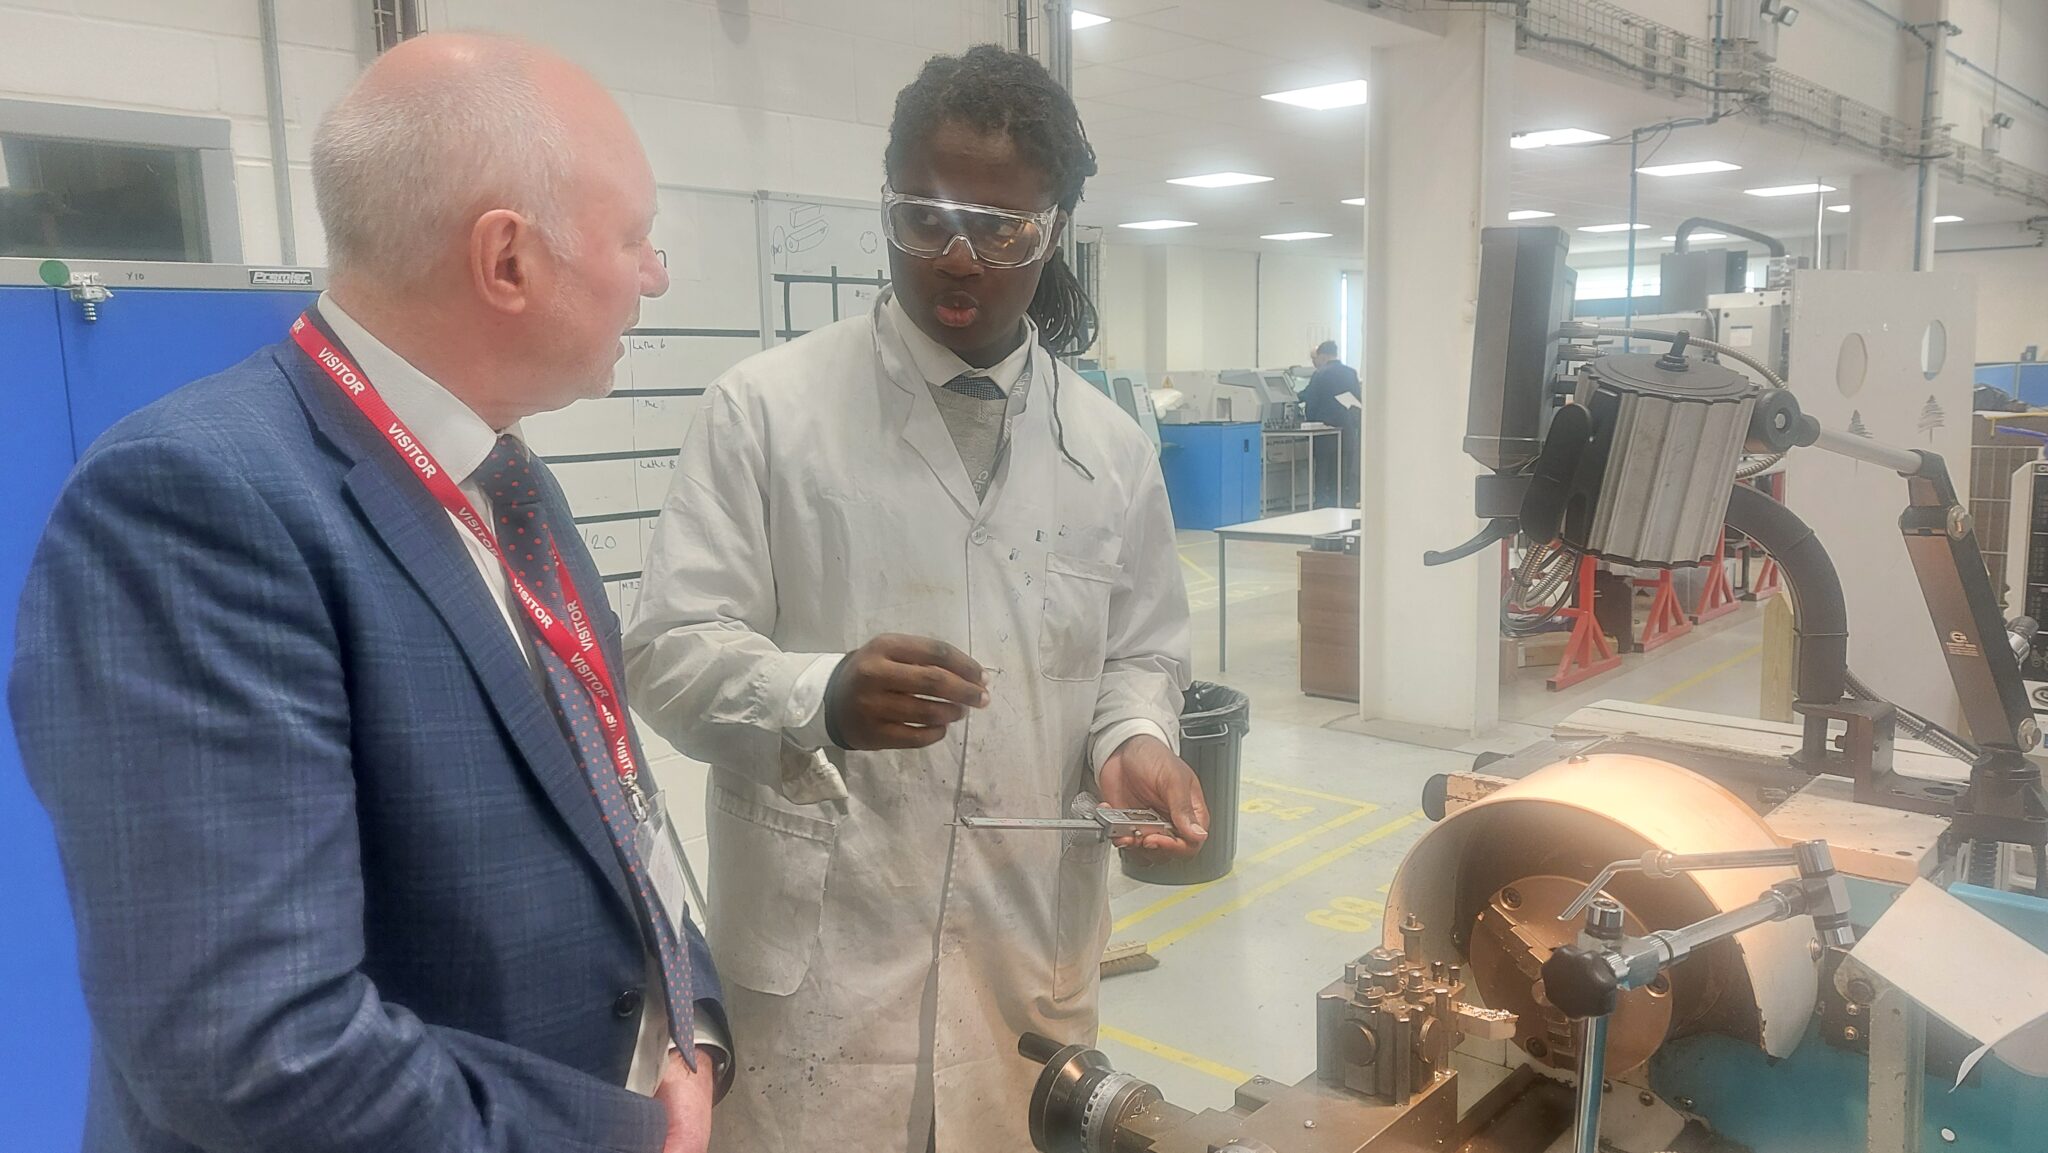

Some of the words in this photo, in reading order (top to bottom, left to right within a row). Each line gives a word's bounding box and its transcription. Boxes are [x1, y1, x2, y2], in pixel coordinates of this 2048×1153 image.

[318, 347, 366, 395] VISITOR
[388, 423, 437, 478] VISITOR
[458, 507, 499, 557] VISITOR
[514, 578, 554, 629] VISITOR
[567, 600, 594, 652] VISITOR
[570, 652, 609, 698] VISITOR
